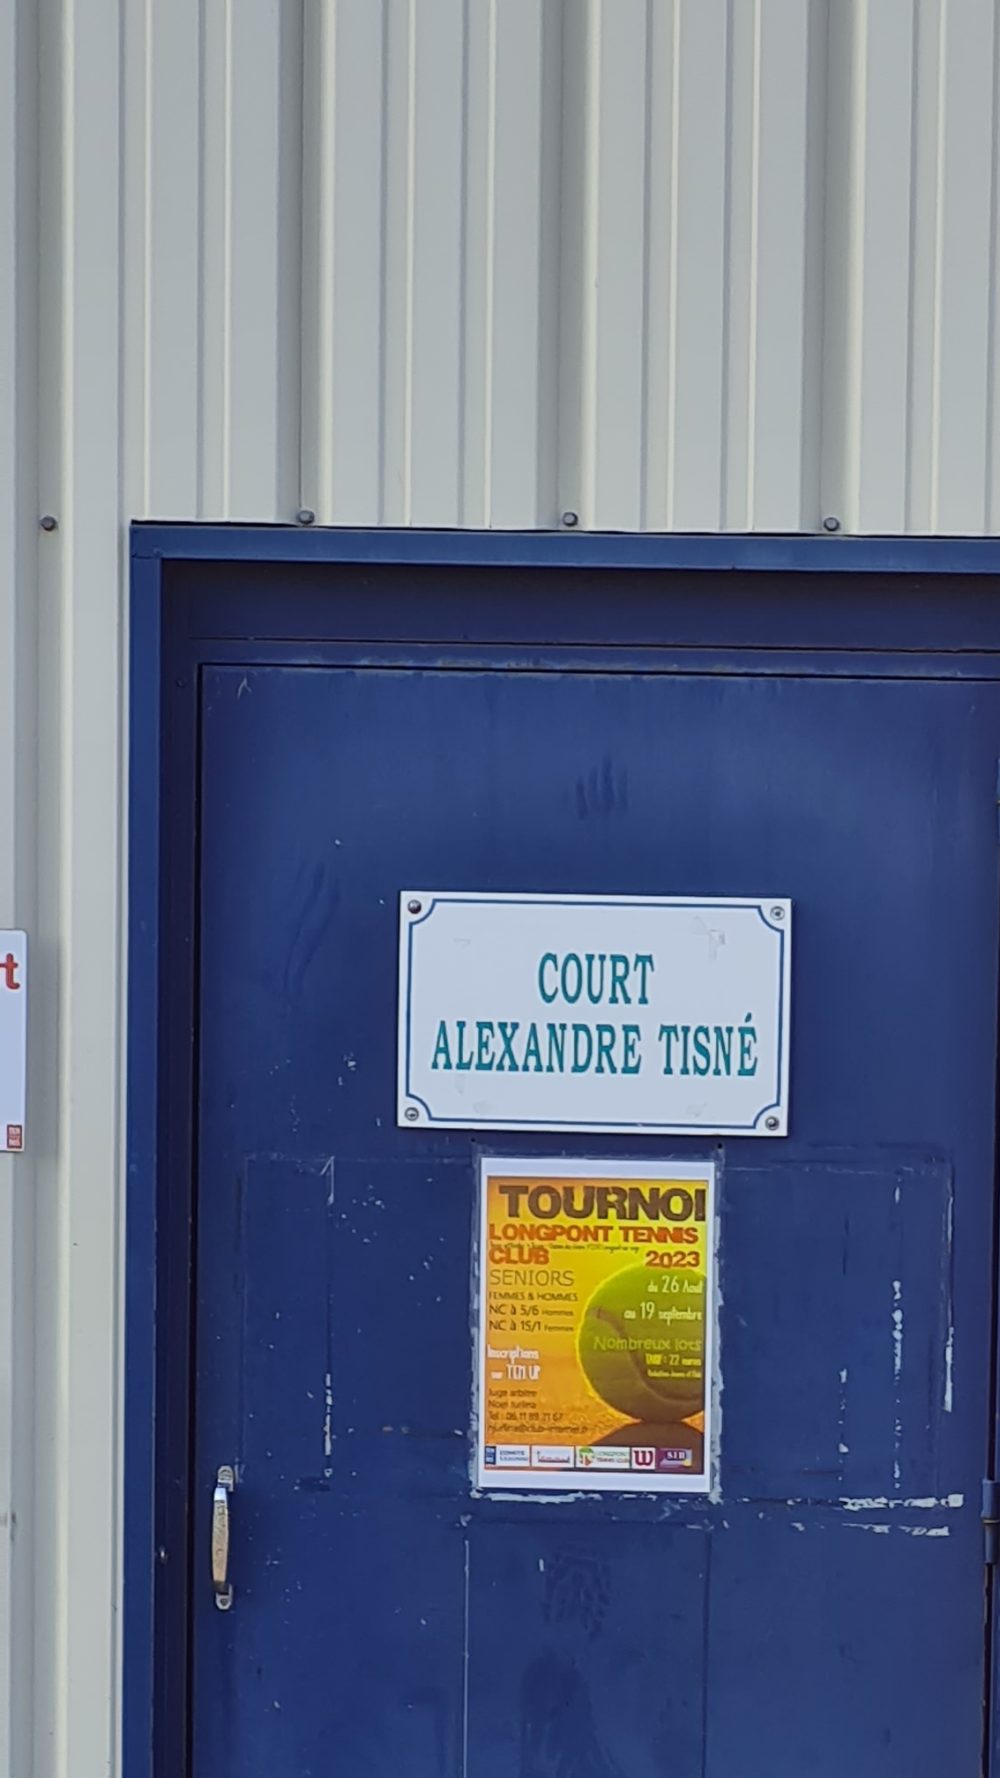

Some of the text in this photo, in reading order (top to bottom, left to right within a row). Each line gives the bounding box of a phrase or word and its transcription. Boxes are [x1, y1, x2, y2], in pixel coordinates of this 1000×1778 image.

[538, 952, 655, 1005] COURT
[431, 1013, 759, 1077] ALEXANDRE TISNÉ
[499, 1185, 706, 1222] TOURNOI
[489, 1223, 699, 1244] LONGPONT TENNIS
[489, 1246, 550, 1265] CLUB
[645, 1250, 700, 1269] 2023
[489, 1269, 575, 1287] SENIORS
[661, 1275, 680, 1293] 26
[489, 1303, 507, 1316] NC
[640, 1301, 656, 1320] 19
[489, 1319, 507, 1332] NC
[593, 1336, 672, 1351] Nombreux
